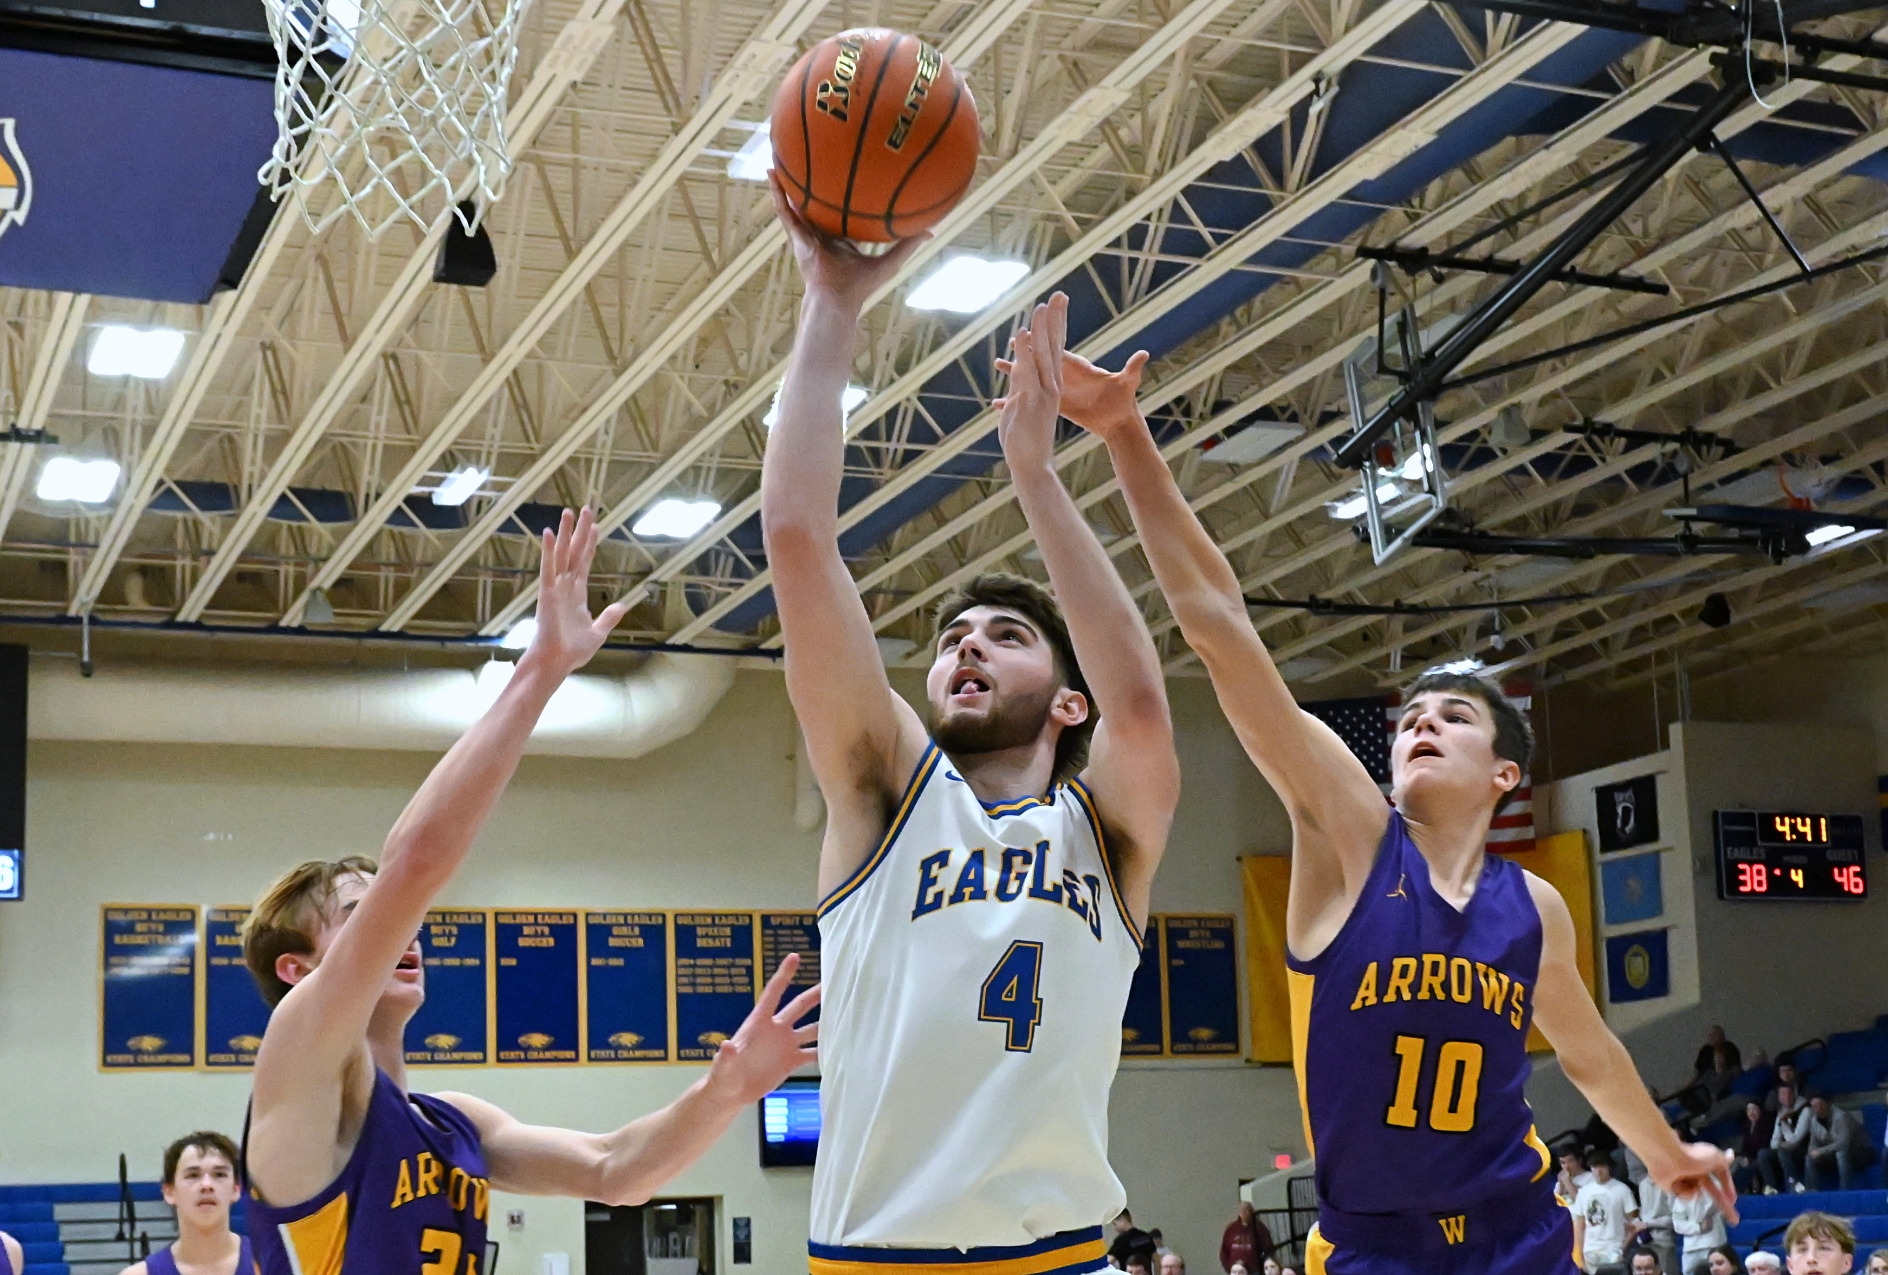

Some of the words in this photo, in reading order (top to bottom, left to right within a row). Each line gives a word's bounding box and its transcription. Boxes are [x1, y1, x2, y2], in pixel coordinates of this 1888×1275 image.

[1774, 815, 1828, 842] 4:41
[1737, 863, 1768, 893] 38
[1790, 868, 1804, 889] 4
[1833, 865, 1865, 895] 46
[978, 940, 1043, 1053] 4
[1349, 952, 1526, 1031] ARROWS
[1384, 1033, 1484, 1133] 10
[1438, 1214, 1467, 1246] W
[420, 1227, 477, 1275] 2
